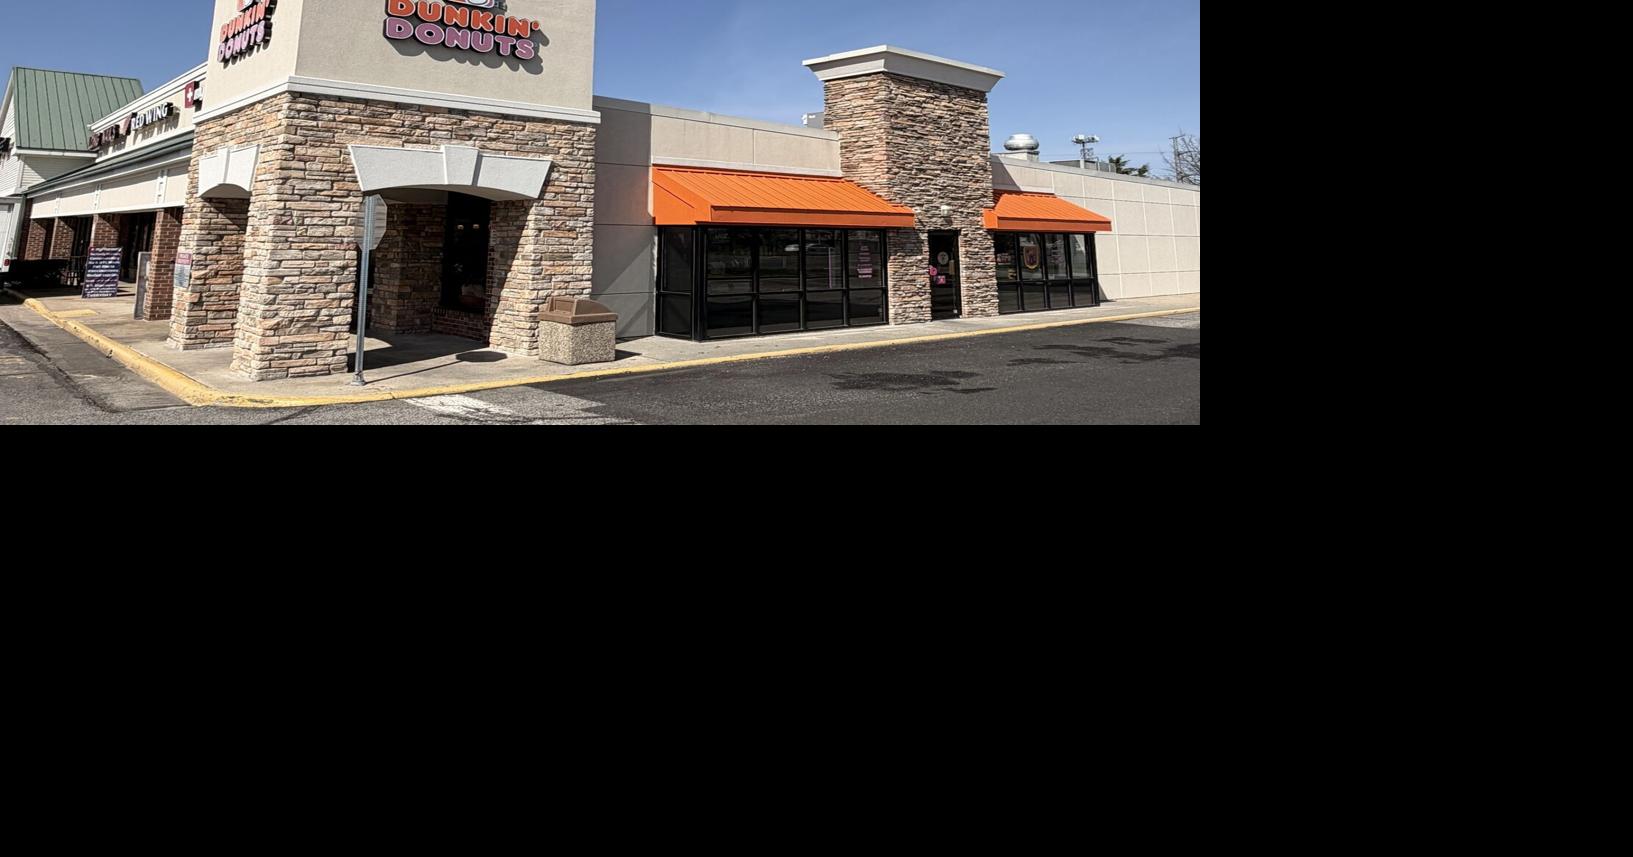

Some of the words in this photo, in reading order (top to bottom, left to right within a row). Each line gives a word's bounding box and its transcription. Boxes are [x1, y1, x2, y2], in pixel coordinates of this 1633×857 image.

[217, 20, 265, 63] DONUTS
[386, 16, 534, 59] DONUTS
[131, 113, 144, 131] RED
[145, 102, 168, 125] WING
